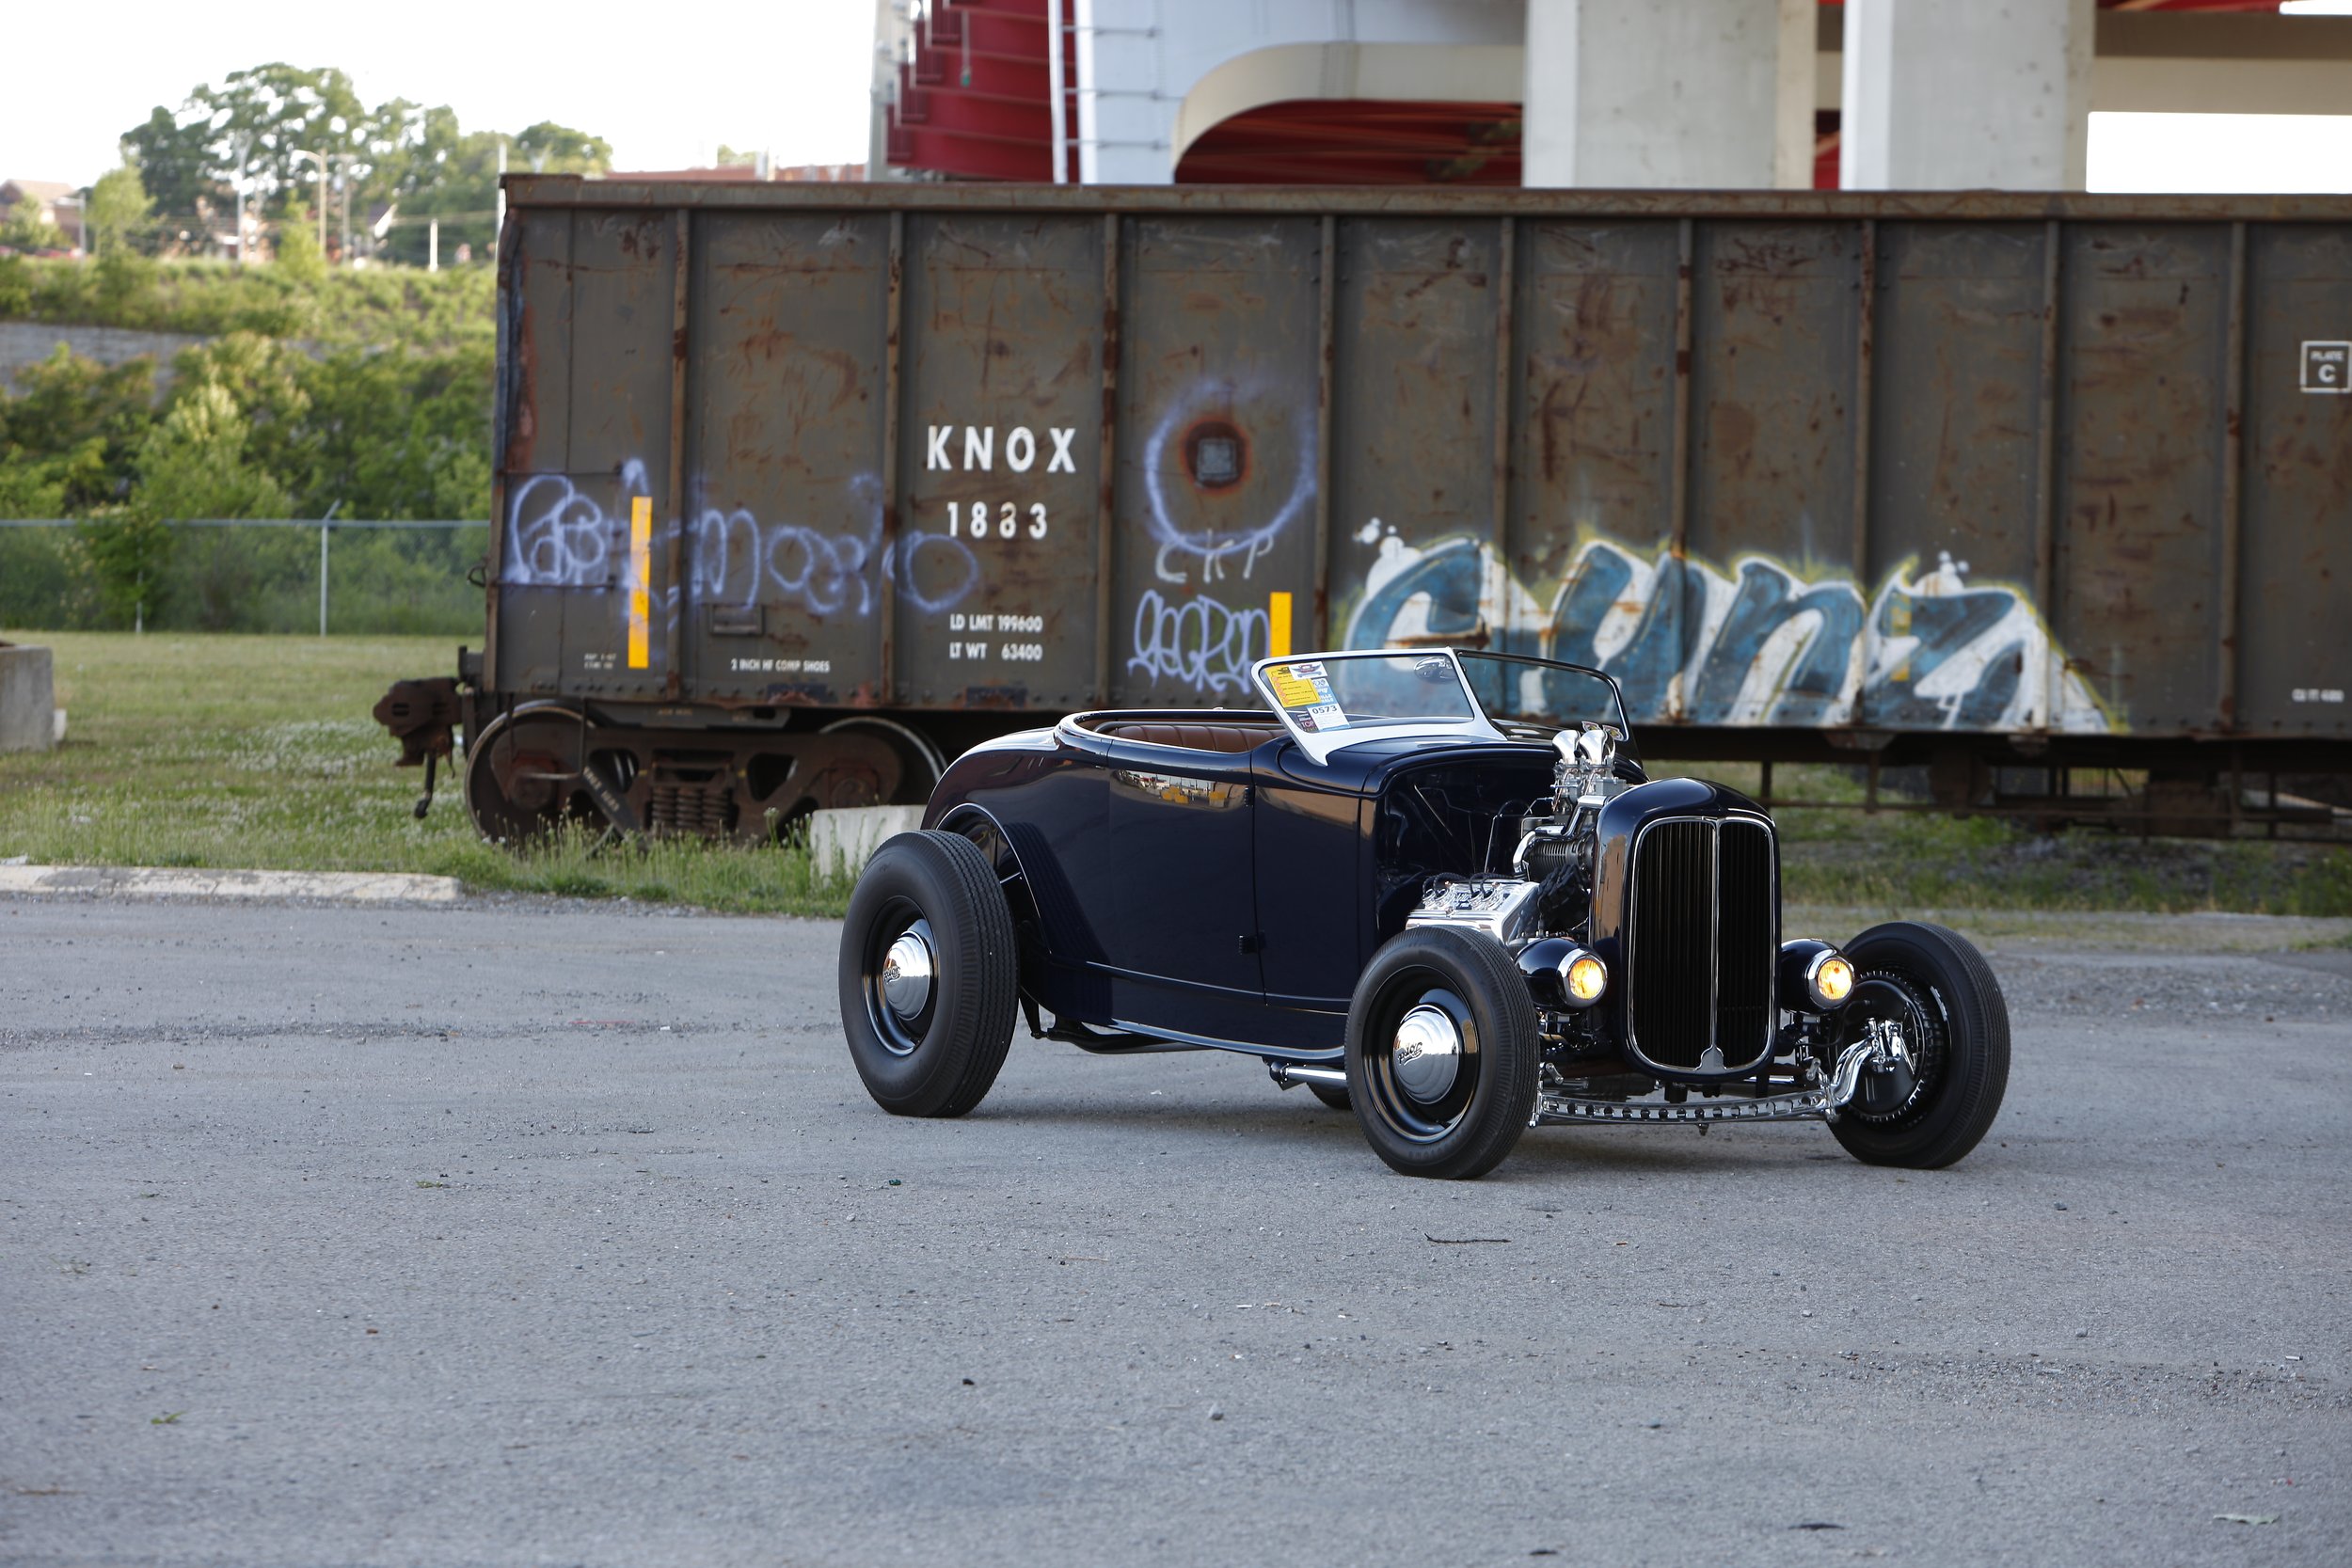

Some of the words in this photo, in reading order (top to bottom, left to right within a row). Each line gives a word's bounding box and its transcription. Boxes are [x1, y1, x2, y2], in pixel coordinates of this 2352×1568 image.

[2318, 364, 2336, 384] C
[927, 425, 1076, 473] KNOX
[947, 501, 1047, 539] 1883
[949, 613, 965, 631] LD
[969, 614, 993, 631] LMT
[997, 614, 1043, 633] 199600
[949, 641, 962, 658] LT
[965, 642, 988, 659] WT
[1001, 642, 1043, 660] 63400
[739, 658, 761, 672] INCH
[775, 659, 801, 673] COMP
[803, 660, 830, 673] SHOES
[1311, 705, 1337, 715] 0573
[1398, 1042, 1422, 1066] Ford
